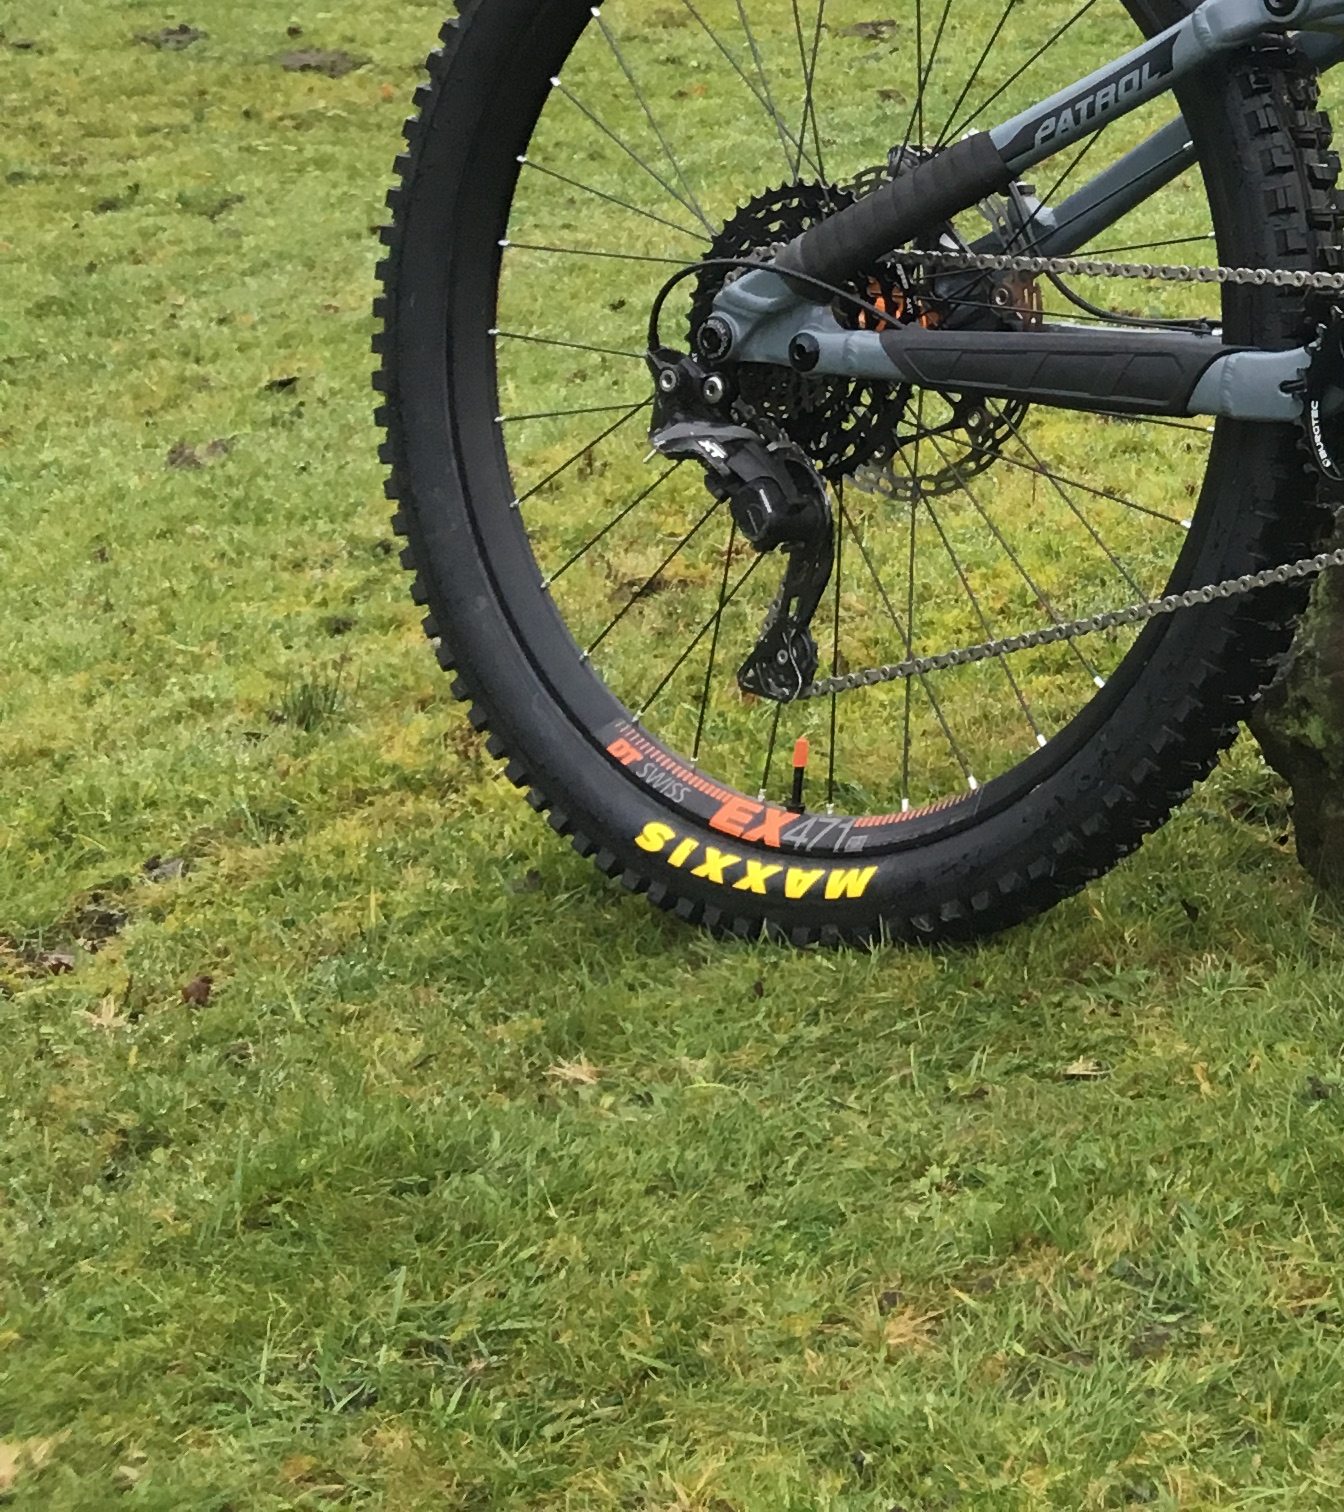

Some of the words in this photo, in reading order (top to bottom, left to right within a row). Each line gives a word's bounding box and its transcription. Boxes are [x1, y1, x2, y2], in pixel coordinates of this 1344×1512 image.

[1034, 61, 1161, 149] PATROL
[1310, 400, 1328, 460] BURGTEC
[606, 737, 645, 767] DT
[634, 761, 691, 804] SWISS
[634, 821, 879, 900] MAXXIS
